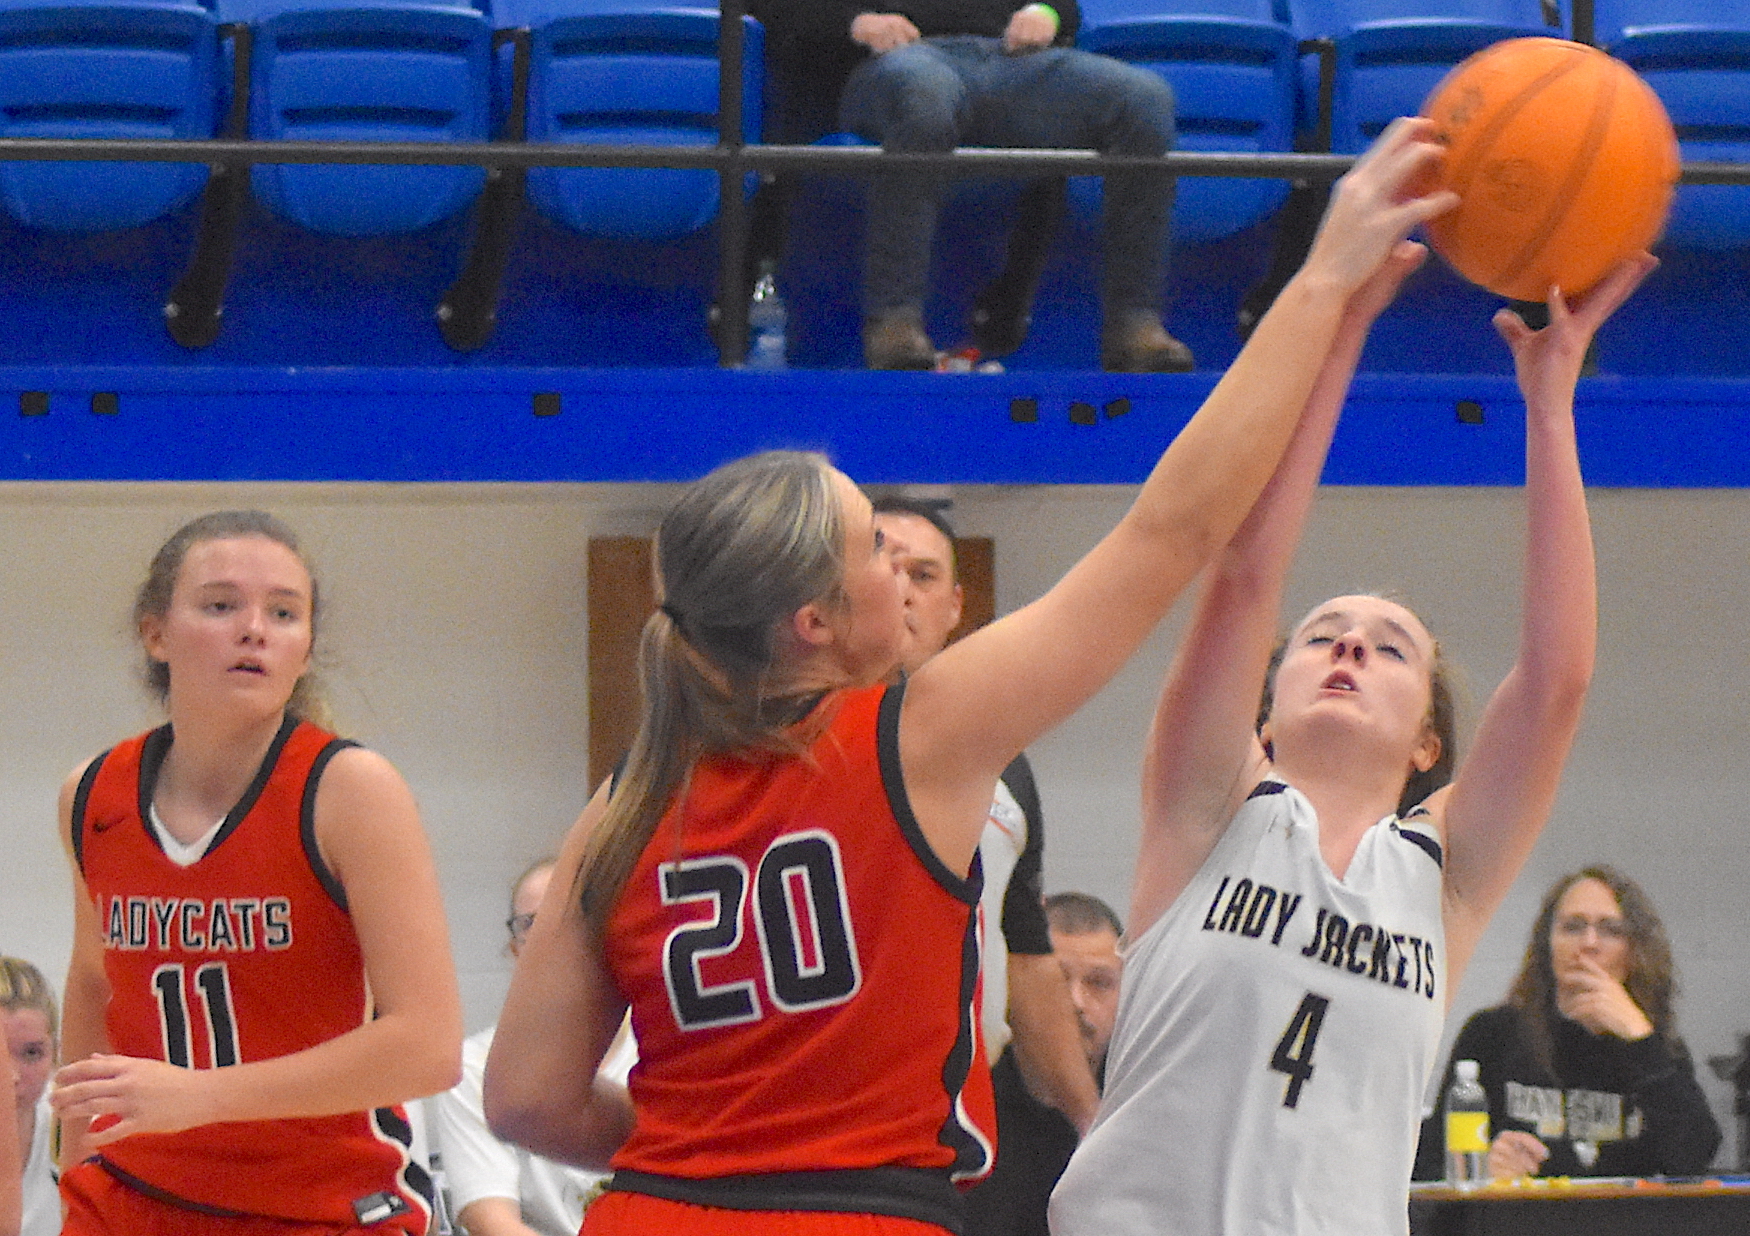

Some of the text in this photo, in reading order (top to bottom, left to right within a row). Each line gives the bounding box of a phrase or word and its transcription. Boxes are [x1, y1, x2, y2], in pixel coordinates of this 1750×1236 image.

[658, 829, 862, 1033] 20
[1201, 876, 1436, 999] LADY JACKETS
[152, 961, 242, 1069] 11
[1268, 990, 1332, 1109] 4
